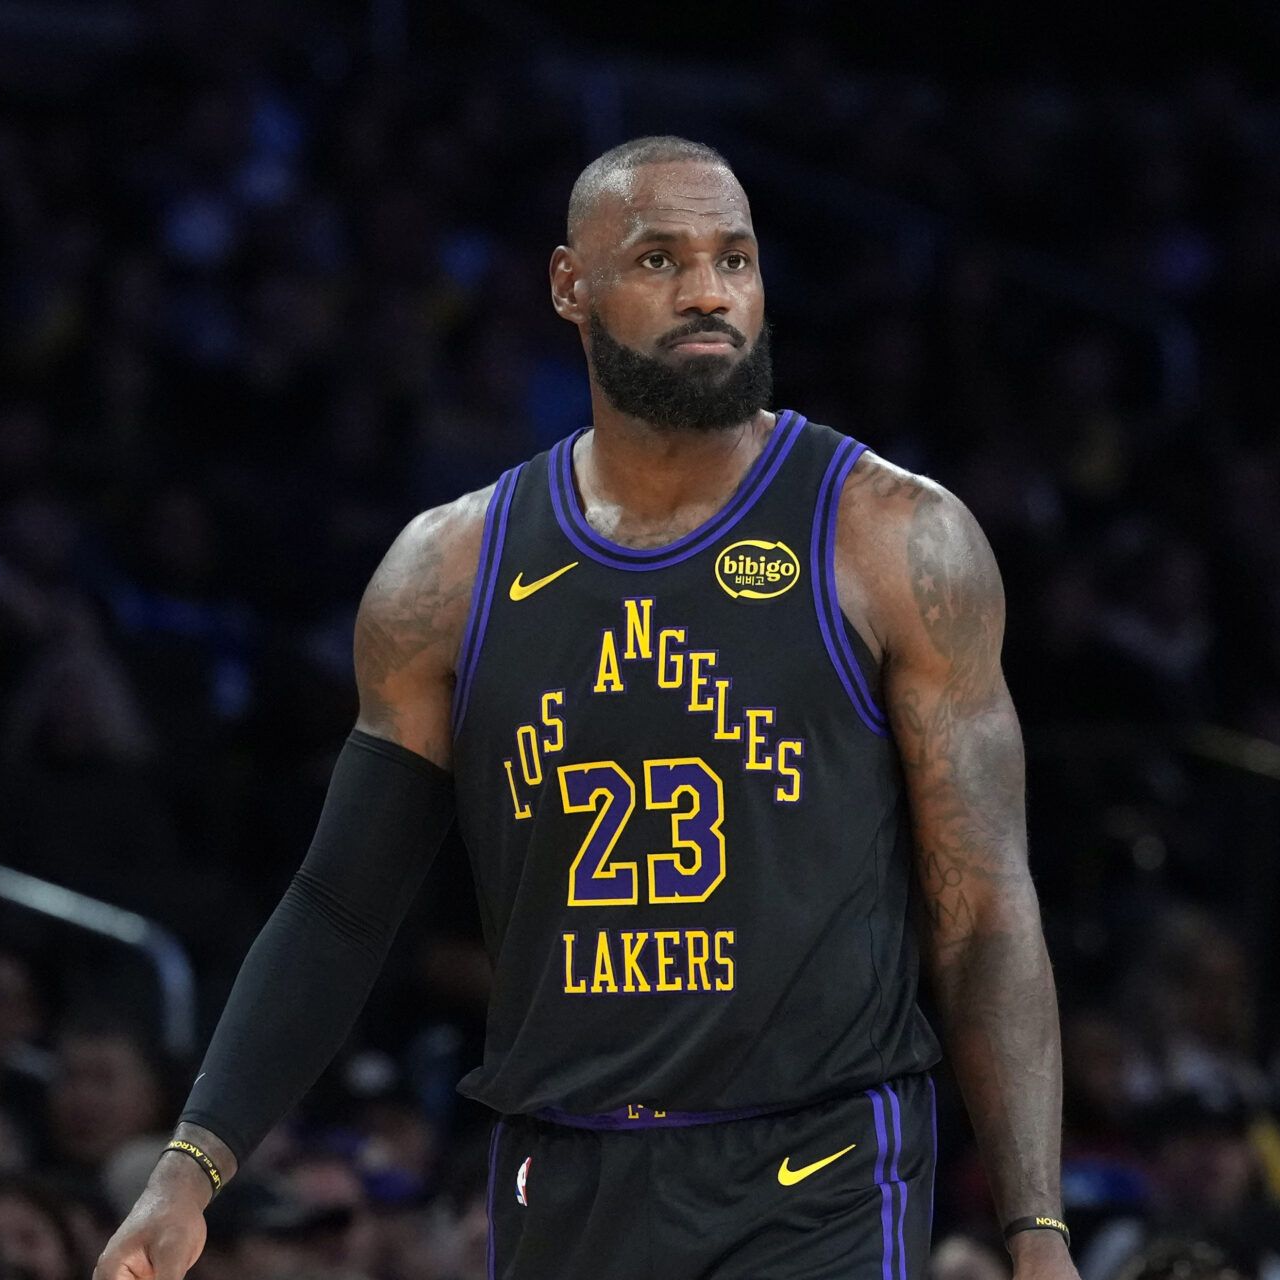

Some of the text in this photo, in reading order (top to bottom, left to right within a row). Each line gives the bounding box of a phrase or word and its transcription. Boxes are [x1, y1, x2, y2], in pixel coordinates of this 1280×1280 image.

[724, 554, 795, 582] bibigo
[735, 575, 765, 586] 비비고
[504, 598, 802, 819] LOS ANGELES
[558, 756, 727, 907] 23
[562, 930, 736, 994] LAKERS
[169, 1140, 203, 1157] AKRON
